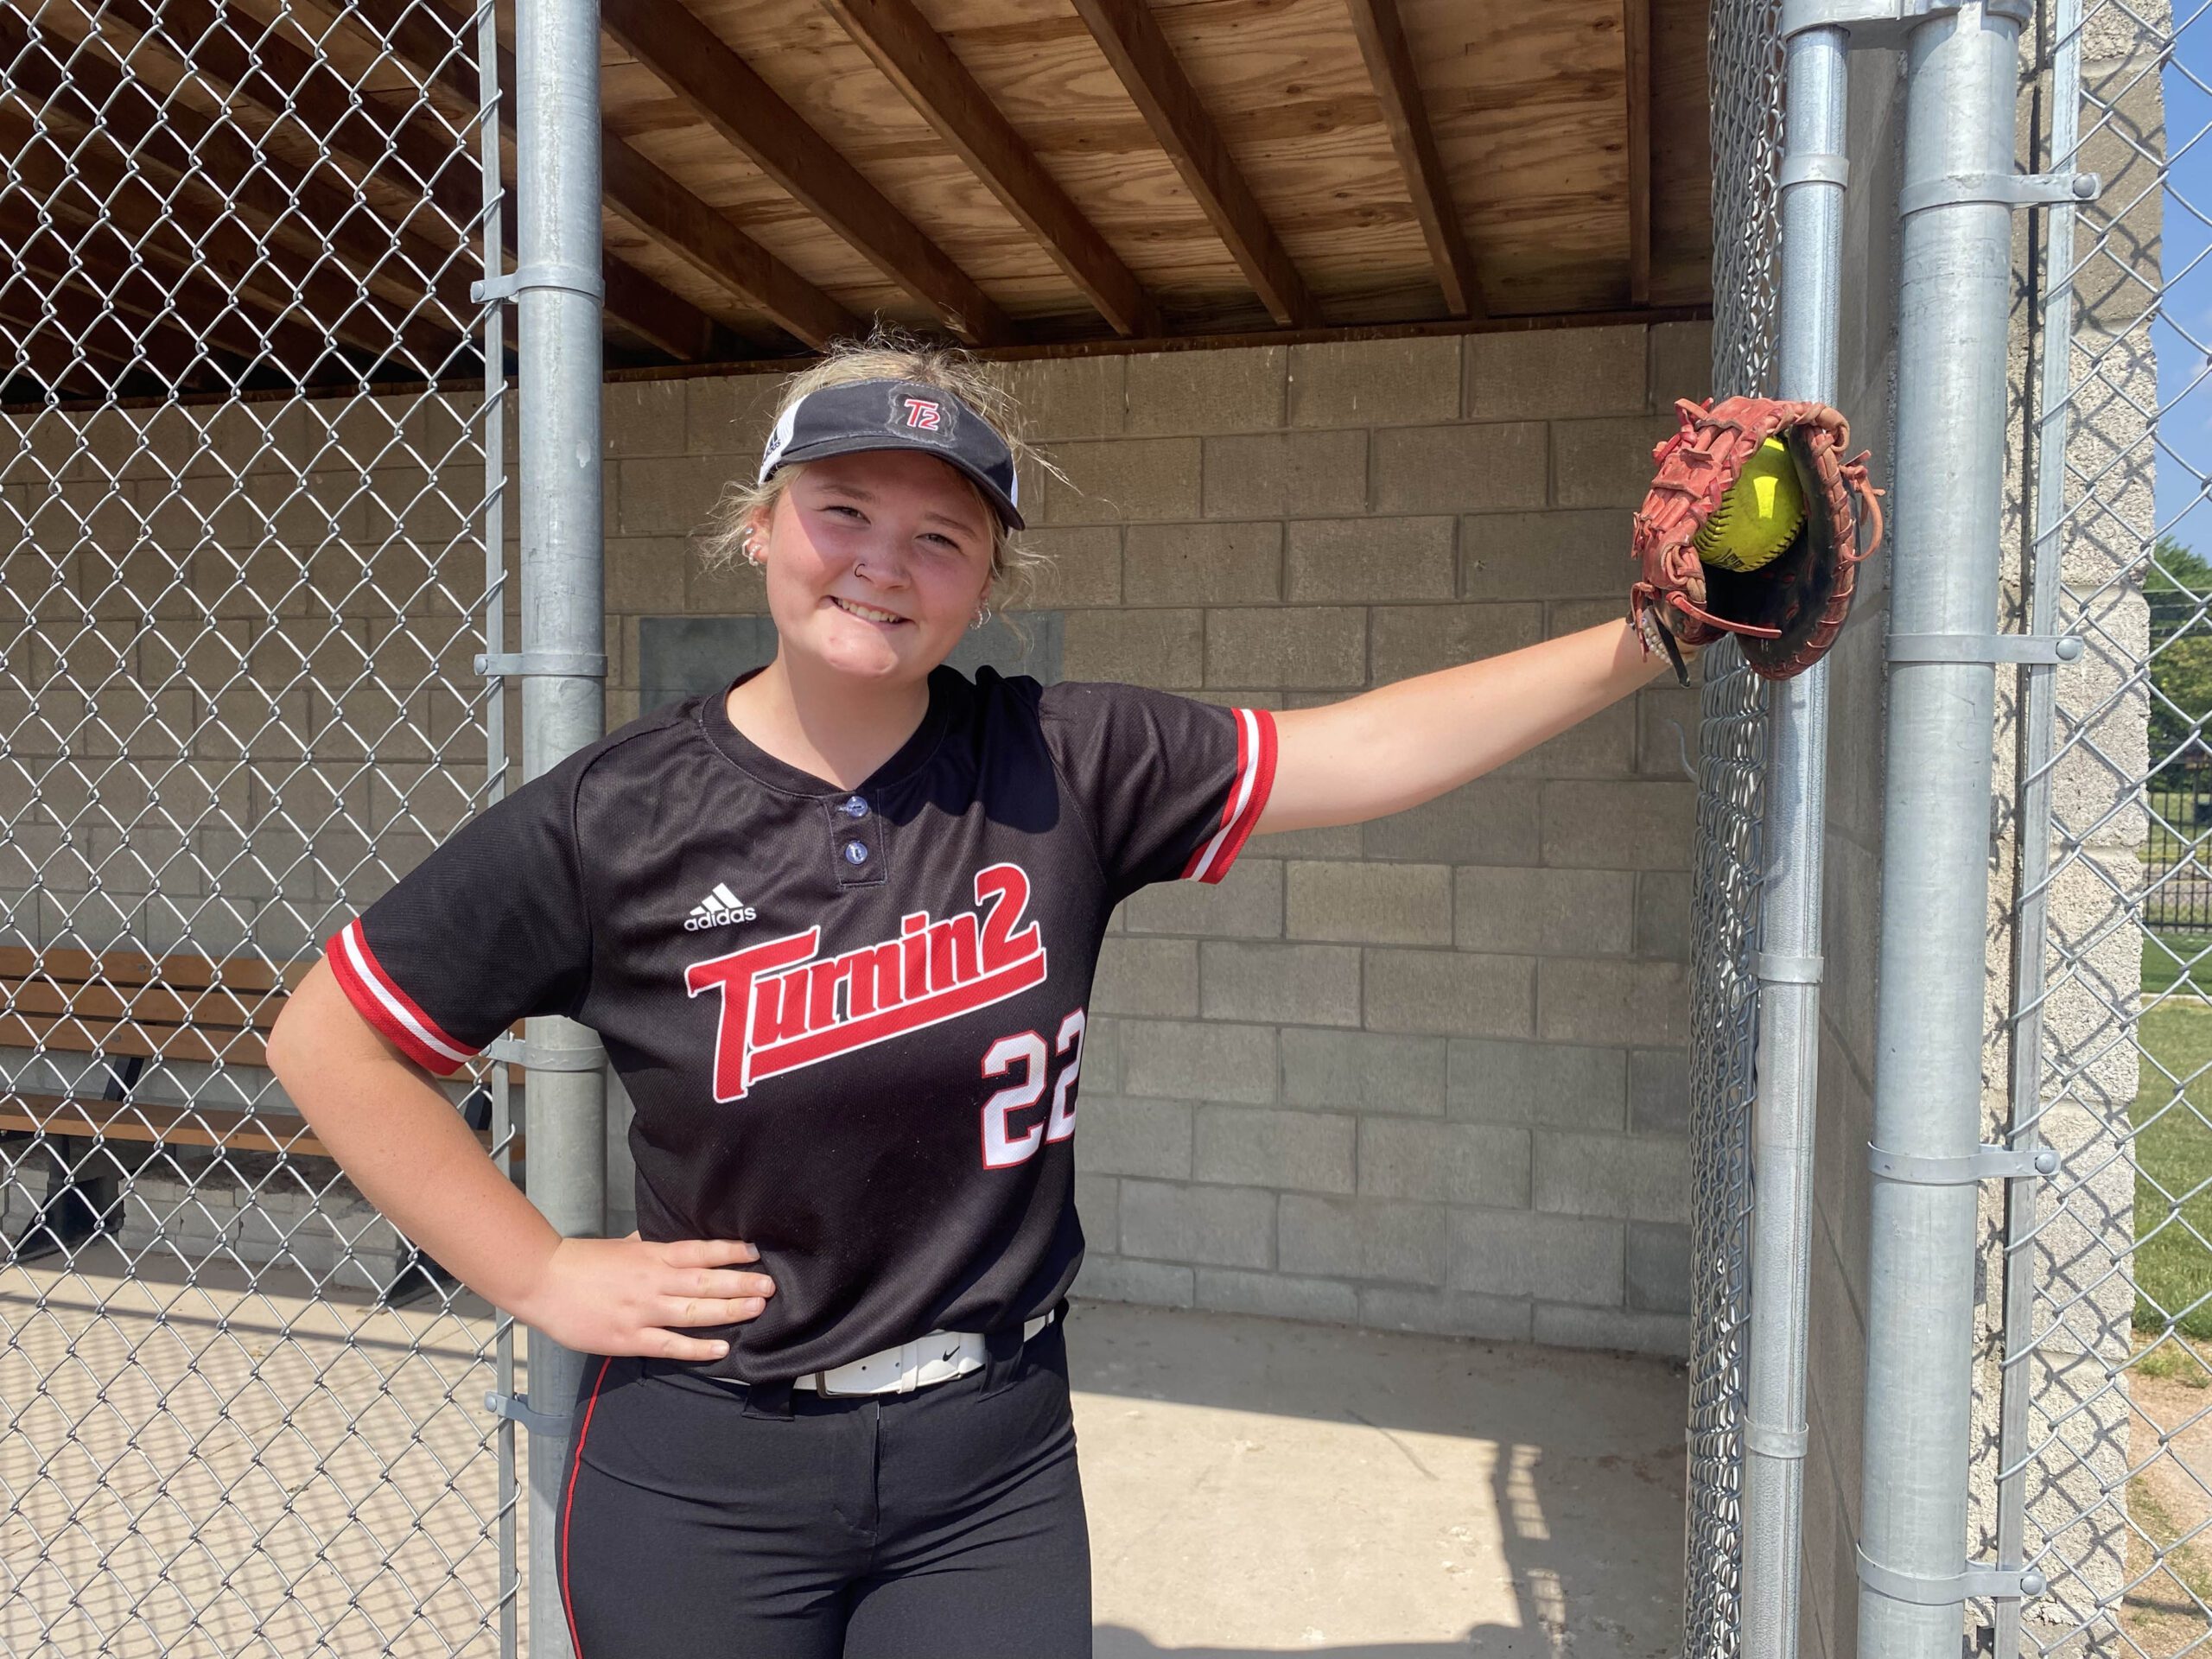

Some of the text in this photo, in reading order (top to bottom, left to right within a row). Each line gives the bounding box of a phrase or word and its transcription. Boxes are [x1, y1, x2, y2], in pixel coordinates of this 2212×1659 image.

[905, 398, 941, 431] T2
[684, 904, 756, 931] adidas
[685, 863, 1046, 1103] Turnin2
[981, 1008, 1085, 1170] 22
